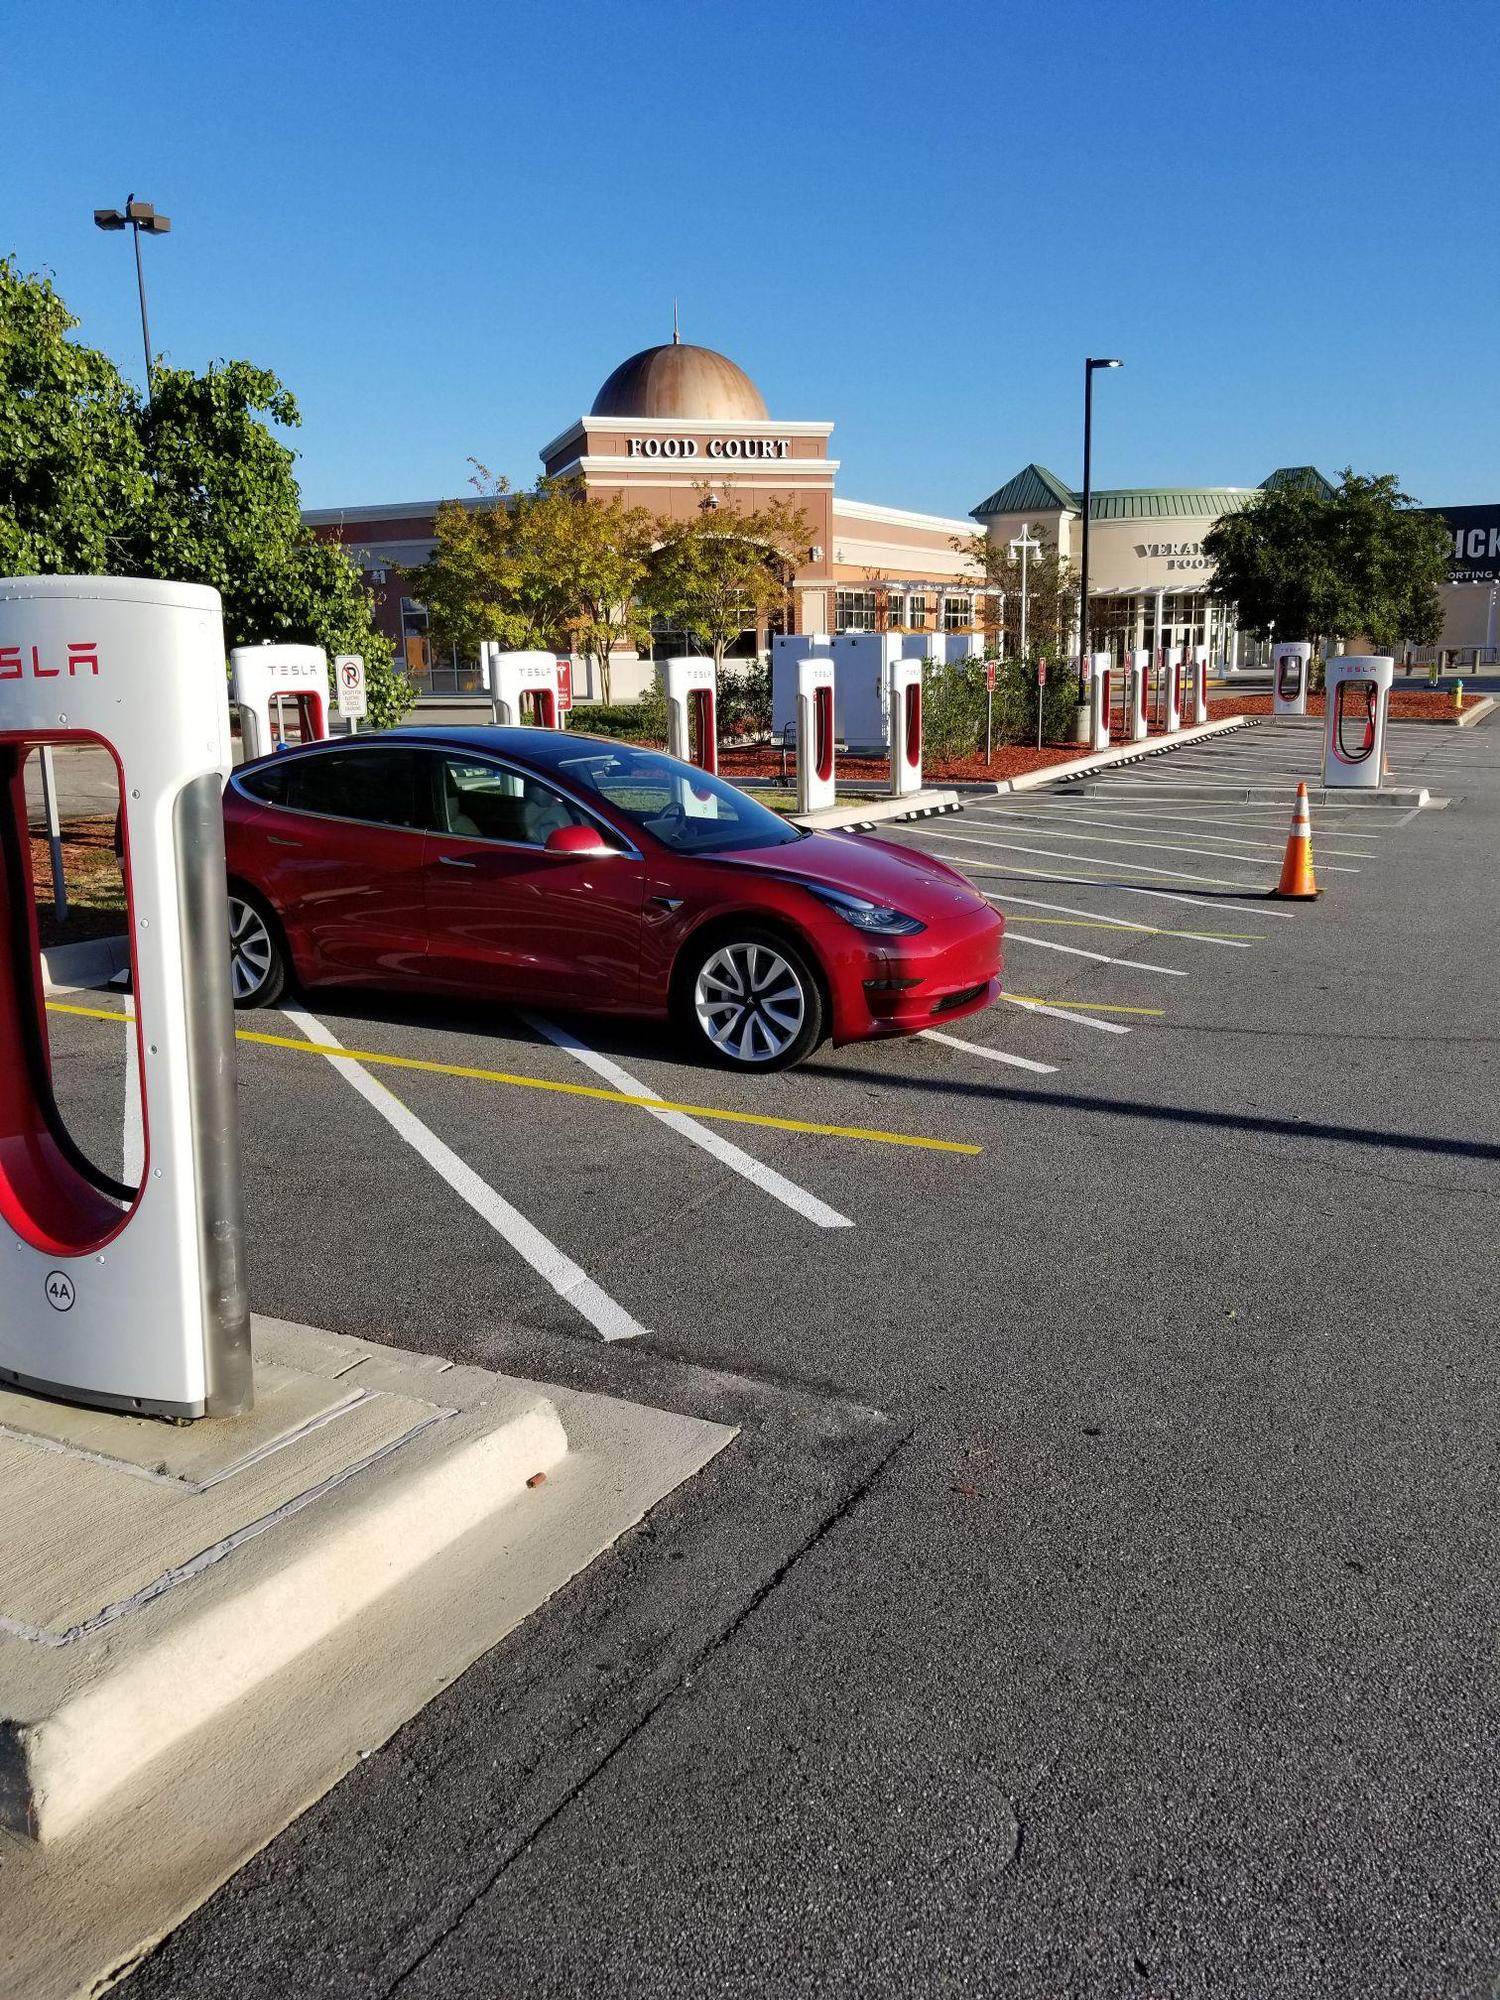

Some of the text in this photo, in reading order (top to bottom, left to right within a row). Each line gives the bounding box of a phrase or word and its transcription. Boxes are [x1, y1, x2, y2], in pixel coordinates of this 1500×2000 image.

[628, 438, 790, 458] FOOD COURT
[1446, 570, 1494, 580] ORTING
[0, 643, 98, 679] SLA
[266, 665, 318, 676] TESLA
[518, 667, 552, 677] TESLA
[1339, 665, 1377, 673] TESLA
[49, 1282, 71, 1300] 4A
